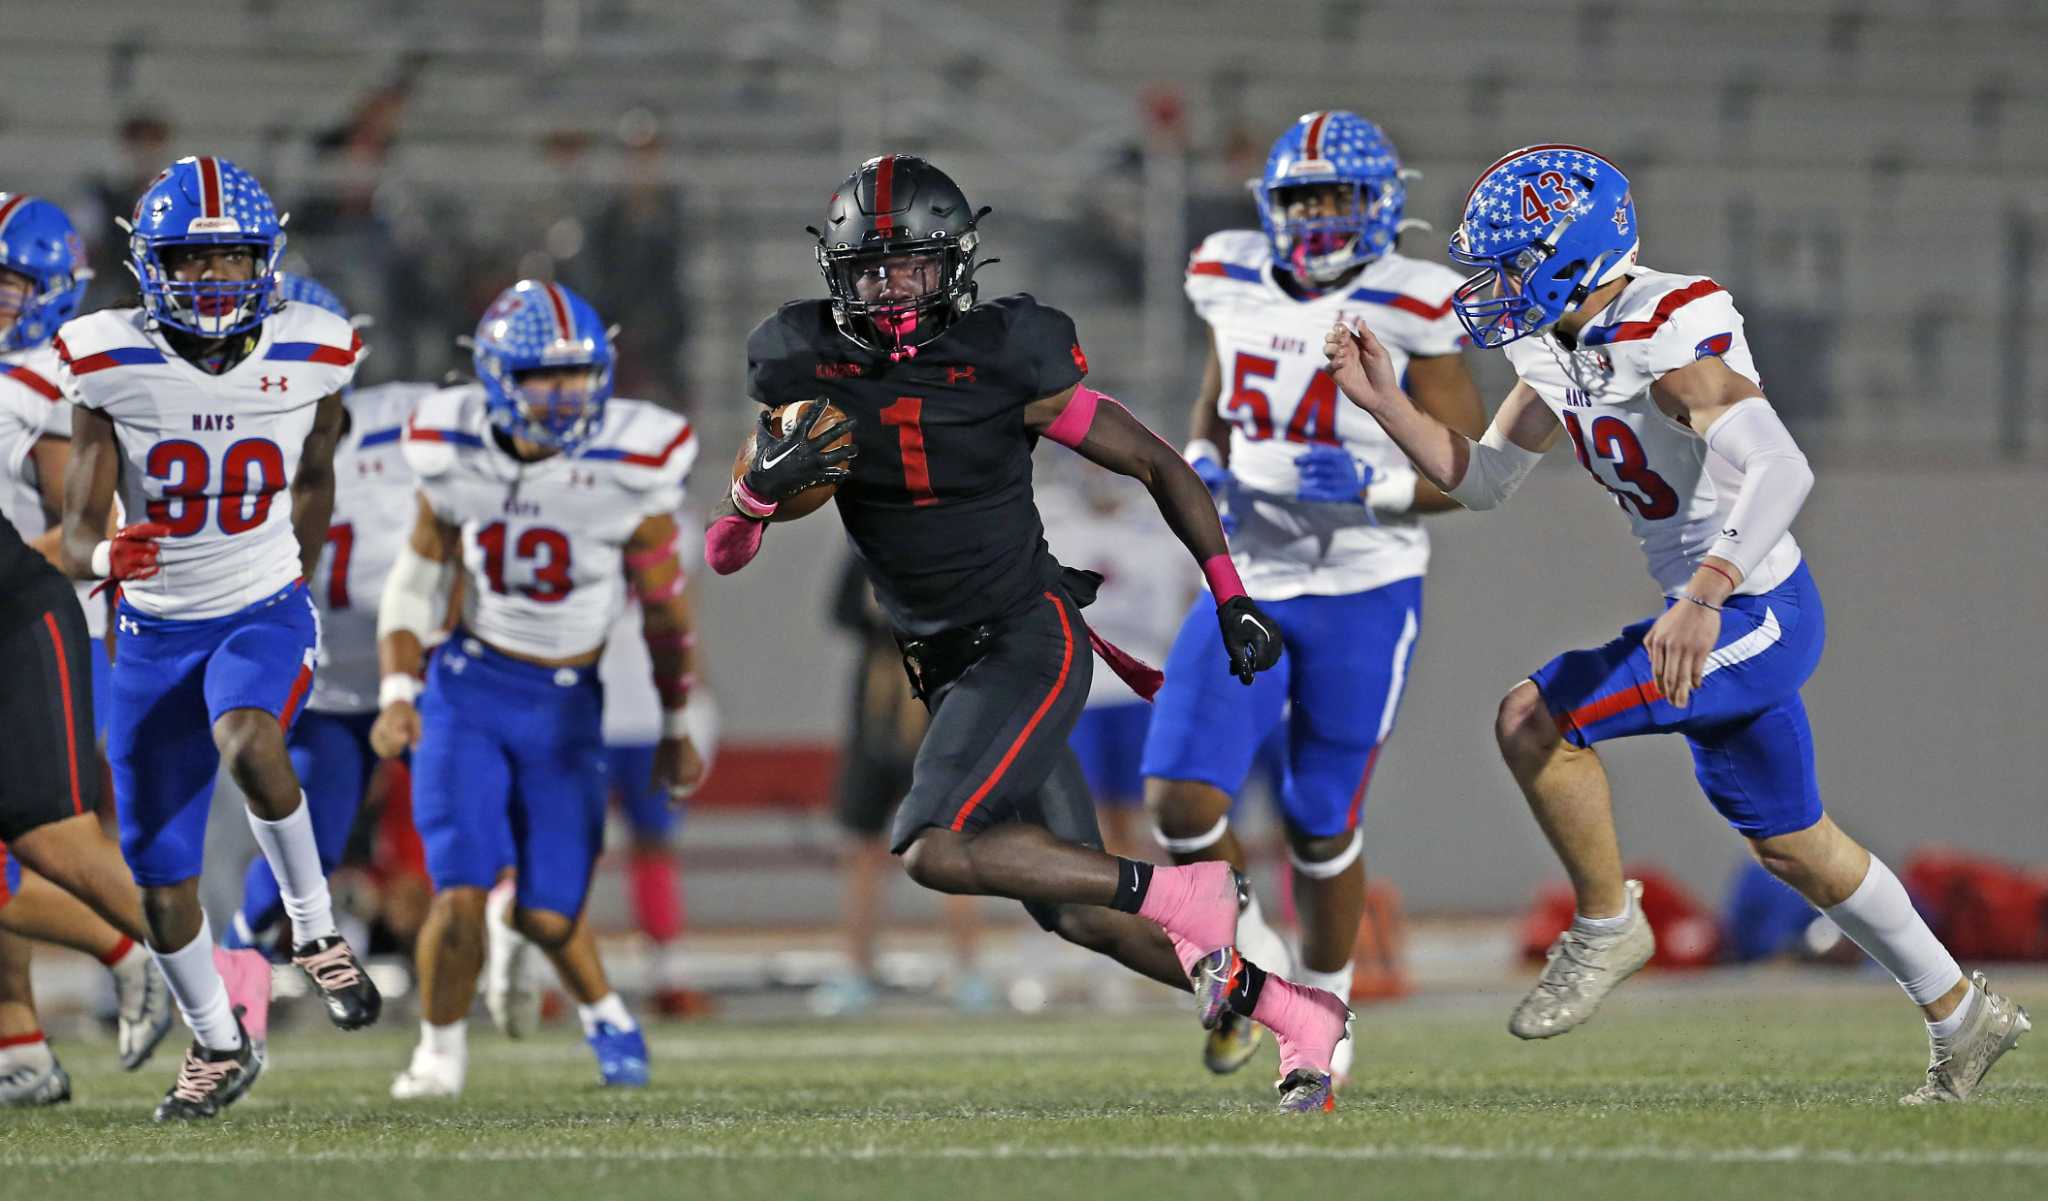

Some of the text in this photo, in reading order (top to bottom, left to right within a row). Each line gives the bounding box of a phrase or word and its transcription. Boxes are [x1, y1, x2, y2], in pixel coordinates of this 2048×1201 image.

[1521, 170, 1578, 223] 43
[192, 414, 235, 431] HAYS
[1227, 350, 1344, 448] 54
[1565, 388, 1592, 408] HAYS
[146, 437, 287, 538] 30
[880, 396, 940, 507] 1
[476, 519, 575, 605] 13
